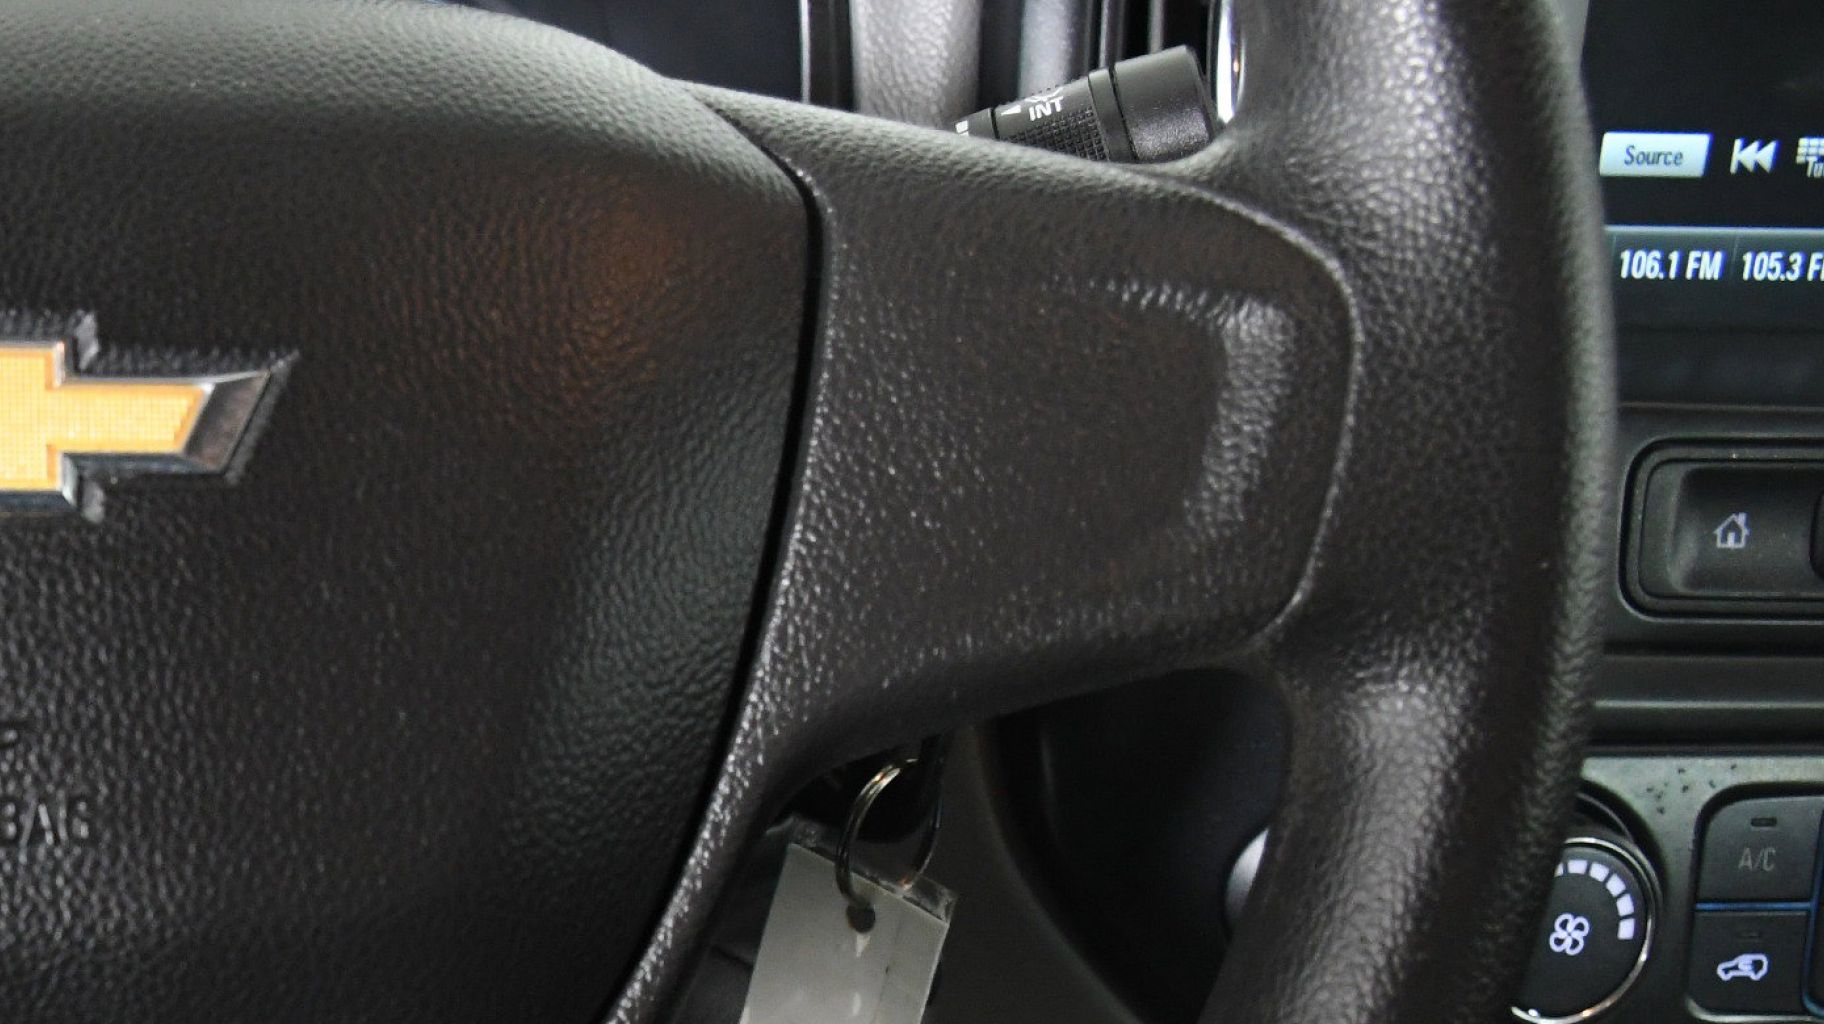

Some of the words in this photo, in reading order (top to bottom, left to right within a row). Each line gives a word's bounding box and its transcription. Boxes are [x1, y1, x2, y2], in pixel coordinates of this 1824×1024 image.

[1028, 95, 1064, 122] INT
[1624, 144, 1684, 167] Source
[1620, 249, 1680, 280] 106.1
[1685, 250, 1724, 281] FM
[1742, 250, 1804, 282] 105.3
[1807, 252, 1824, 282] F
[1737, 846, 1776, 872] A/C
